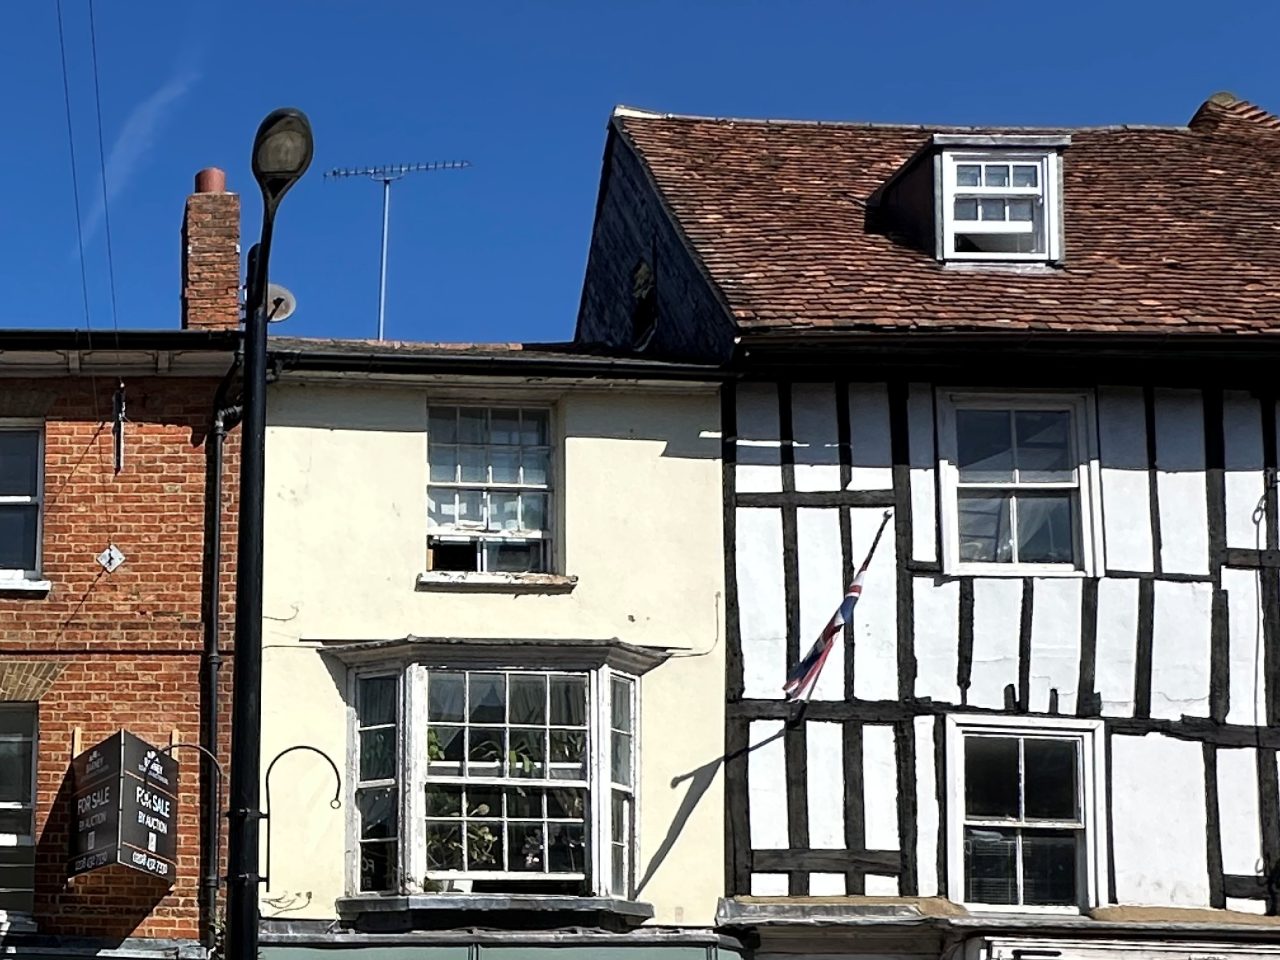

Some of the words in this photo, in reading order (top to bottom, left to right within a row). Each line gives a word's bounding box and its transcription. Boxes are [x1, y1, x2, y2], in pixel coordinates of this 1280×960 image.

[77, 795, 91, 816] FOR
[91, 786, 111, 808] SALE
[152, 794, 171, 818] SALE
[85, 812, 107, 829] AUCTION
[145, 814, 168, 835] AUCTION
